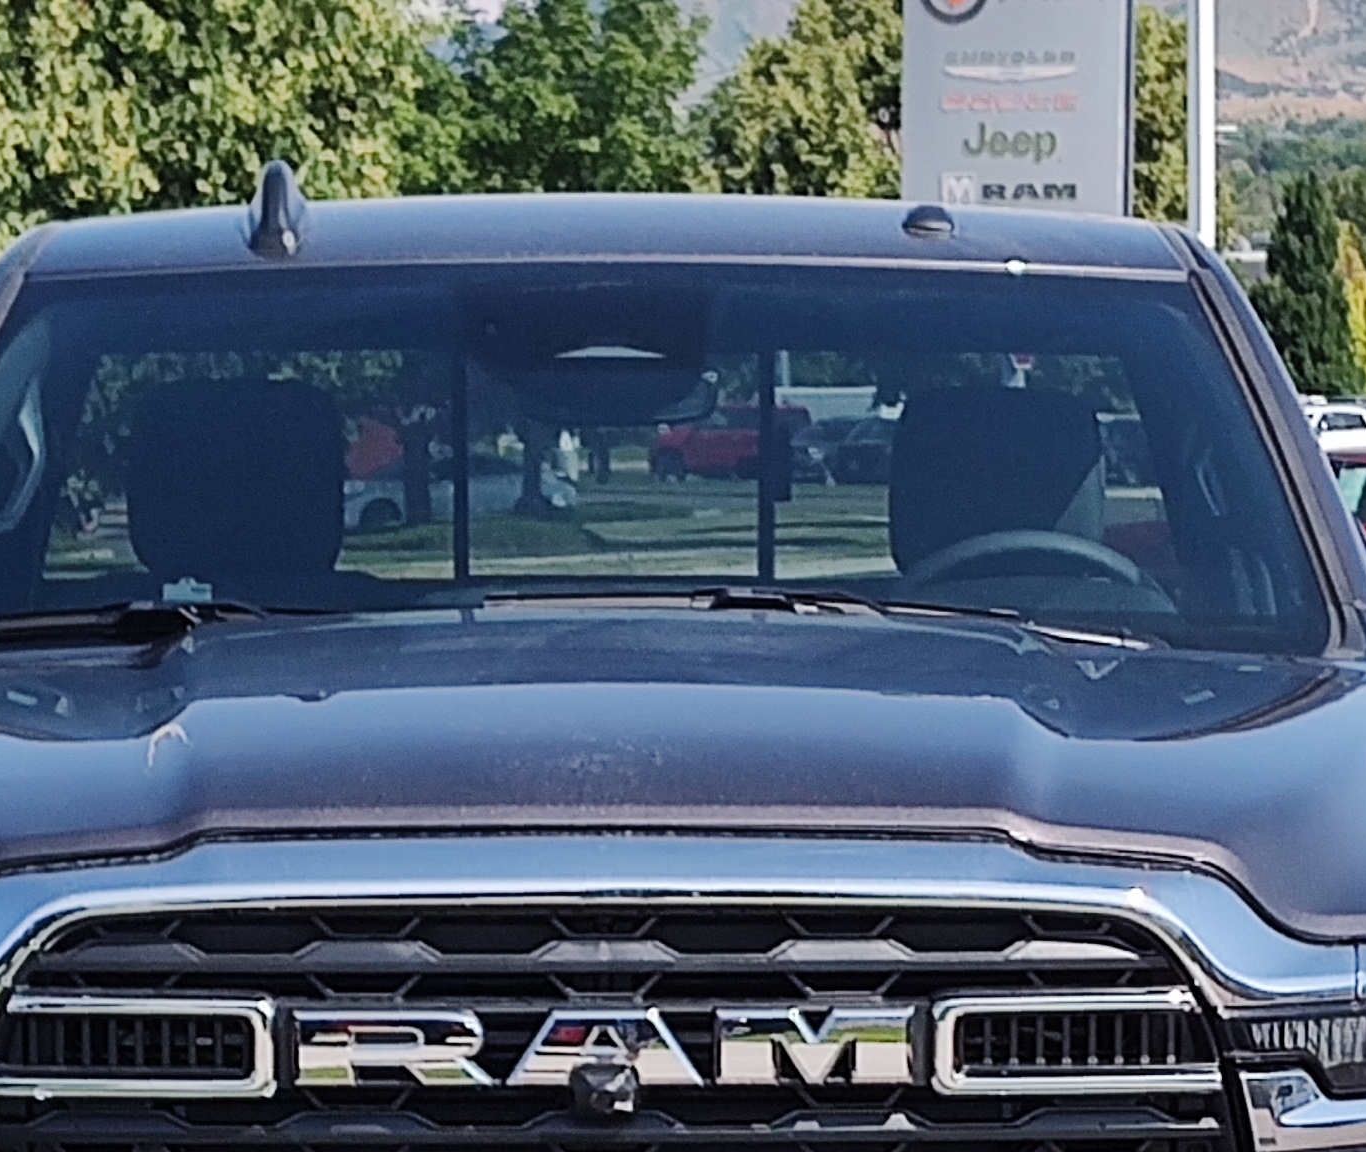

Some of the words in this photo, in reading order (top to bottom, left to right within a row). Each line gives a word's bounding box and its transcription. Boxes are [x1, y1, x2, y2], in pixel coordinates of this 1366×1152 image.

[962, 122, 1057, 163] Jeep
[982, 183, 1077, 200] RAM
[294, 1007, 915, 1086] RAM
